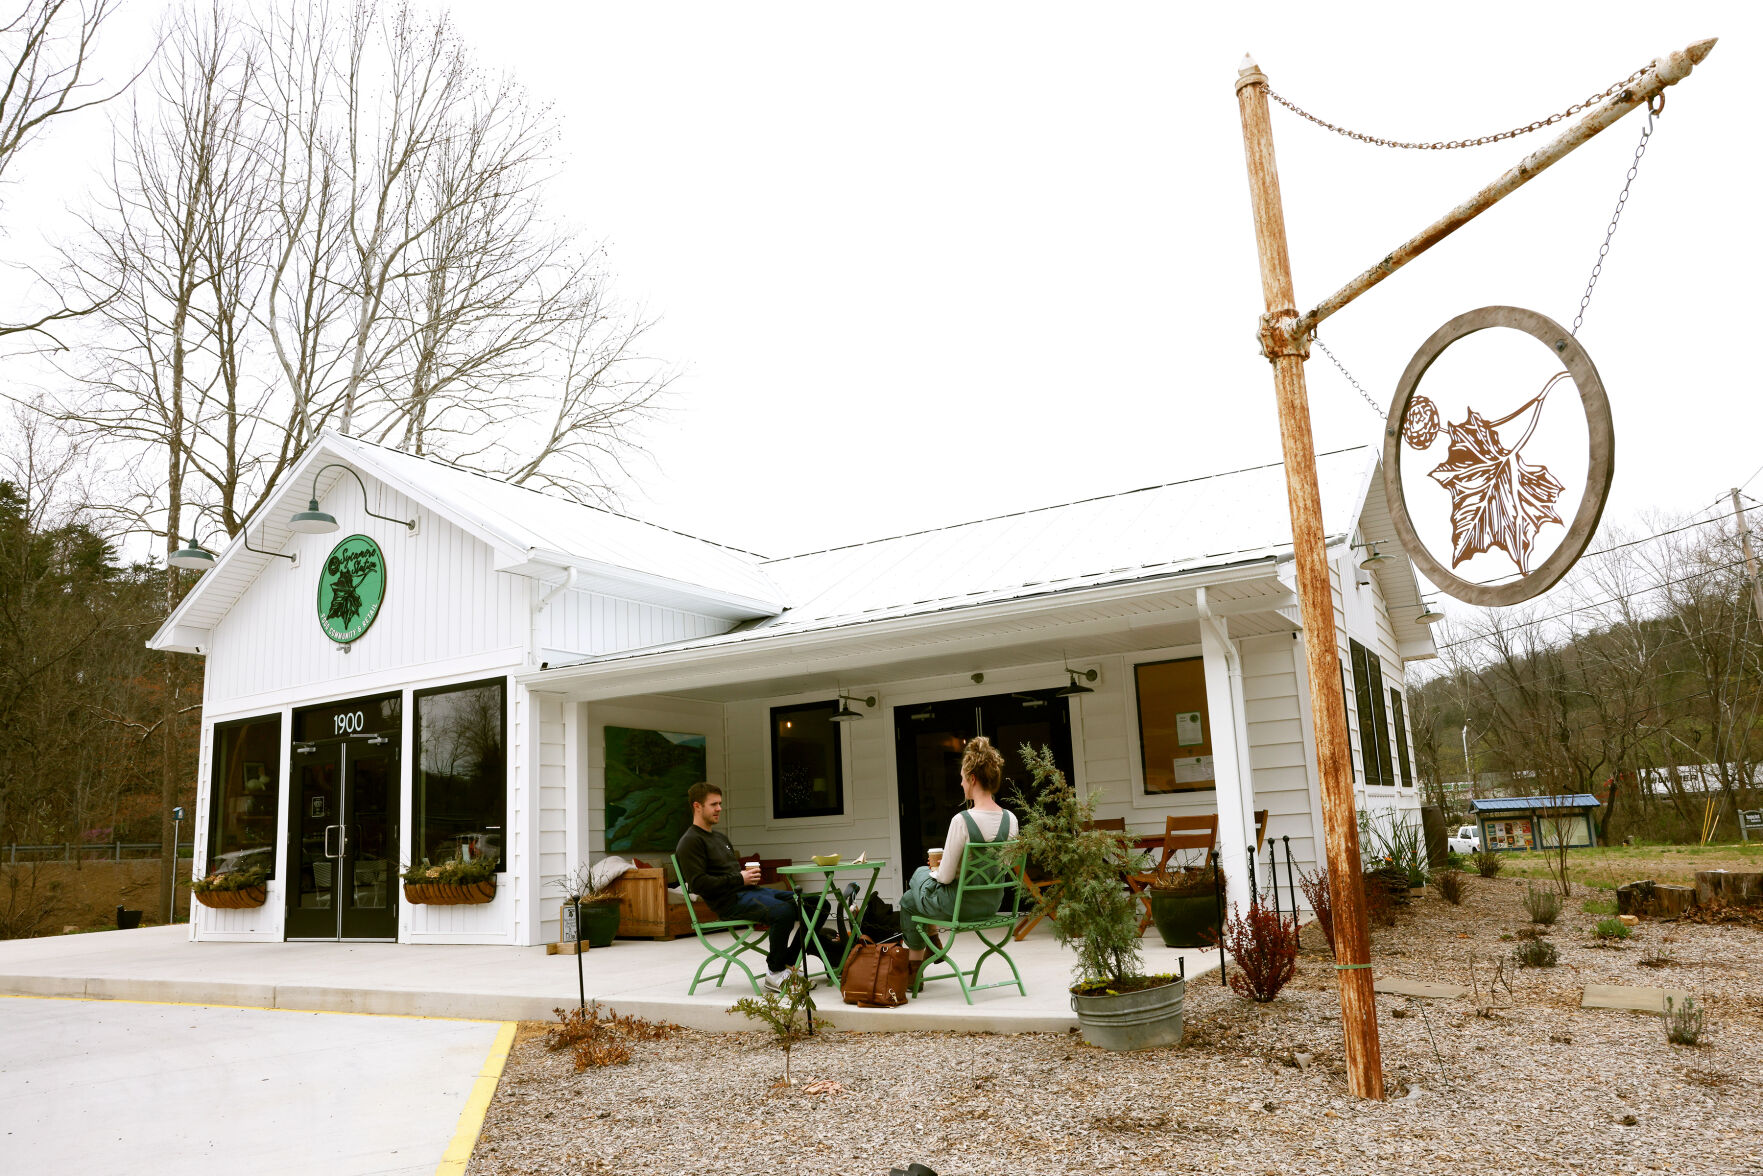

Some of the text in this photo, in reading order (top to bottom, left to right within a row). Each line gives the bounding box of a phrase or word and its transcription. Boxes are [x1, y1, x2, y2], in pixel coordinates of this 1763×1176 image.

[340, 548, 377, 569] Sycamore
[352, 558, 377, 575] Station
[329, 627, 357, 640] COMMUNITY
[362, 603, 378, 628] RETAIL
[333, 711, 364, 735] 1900
